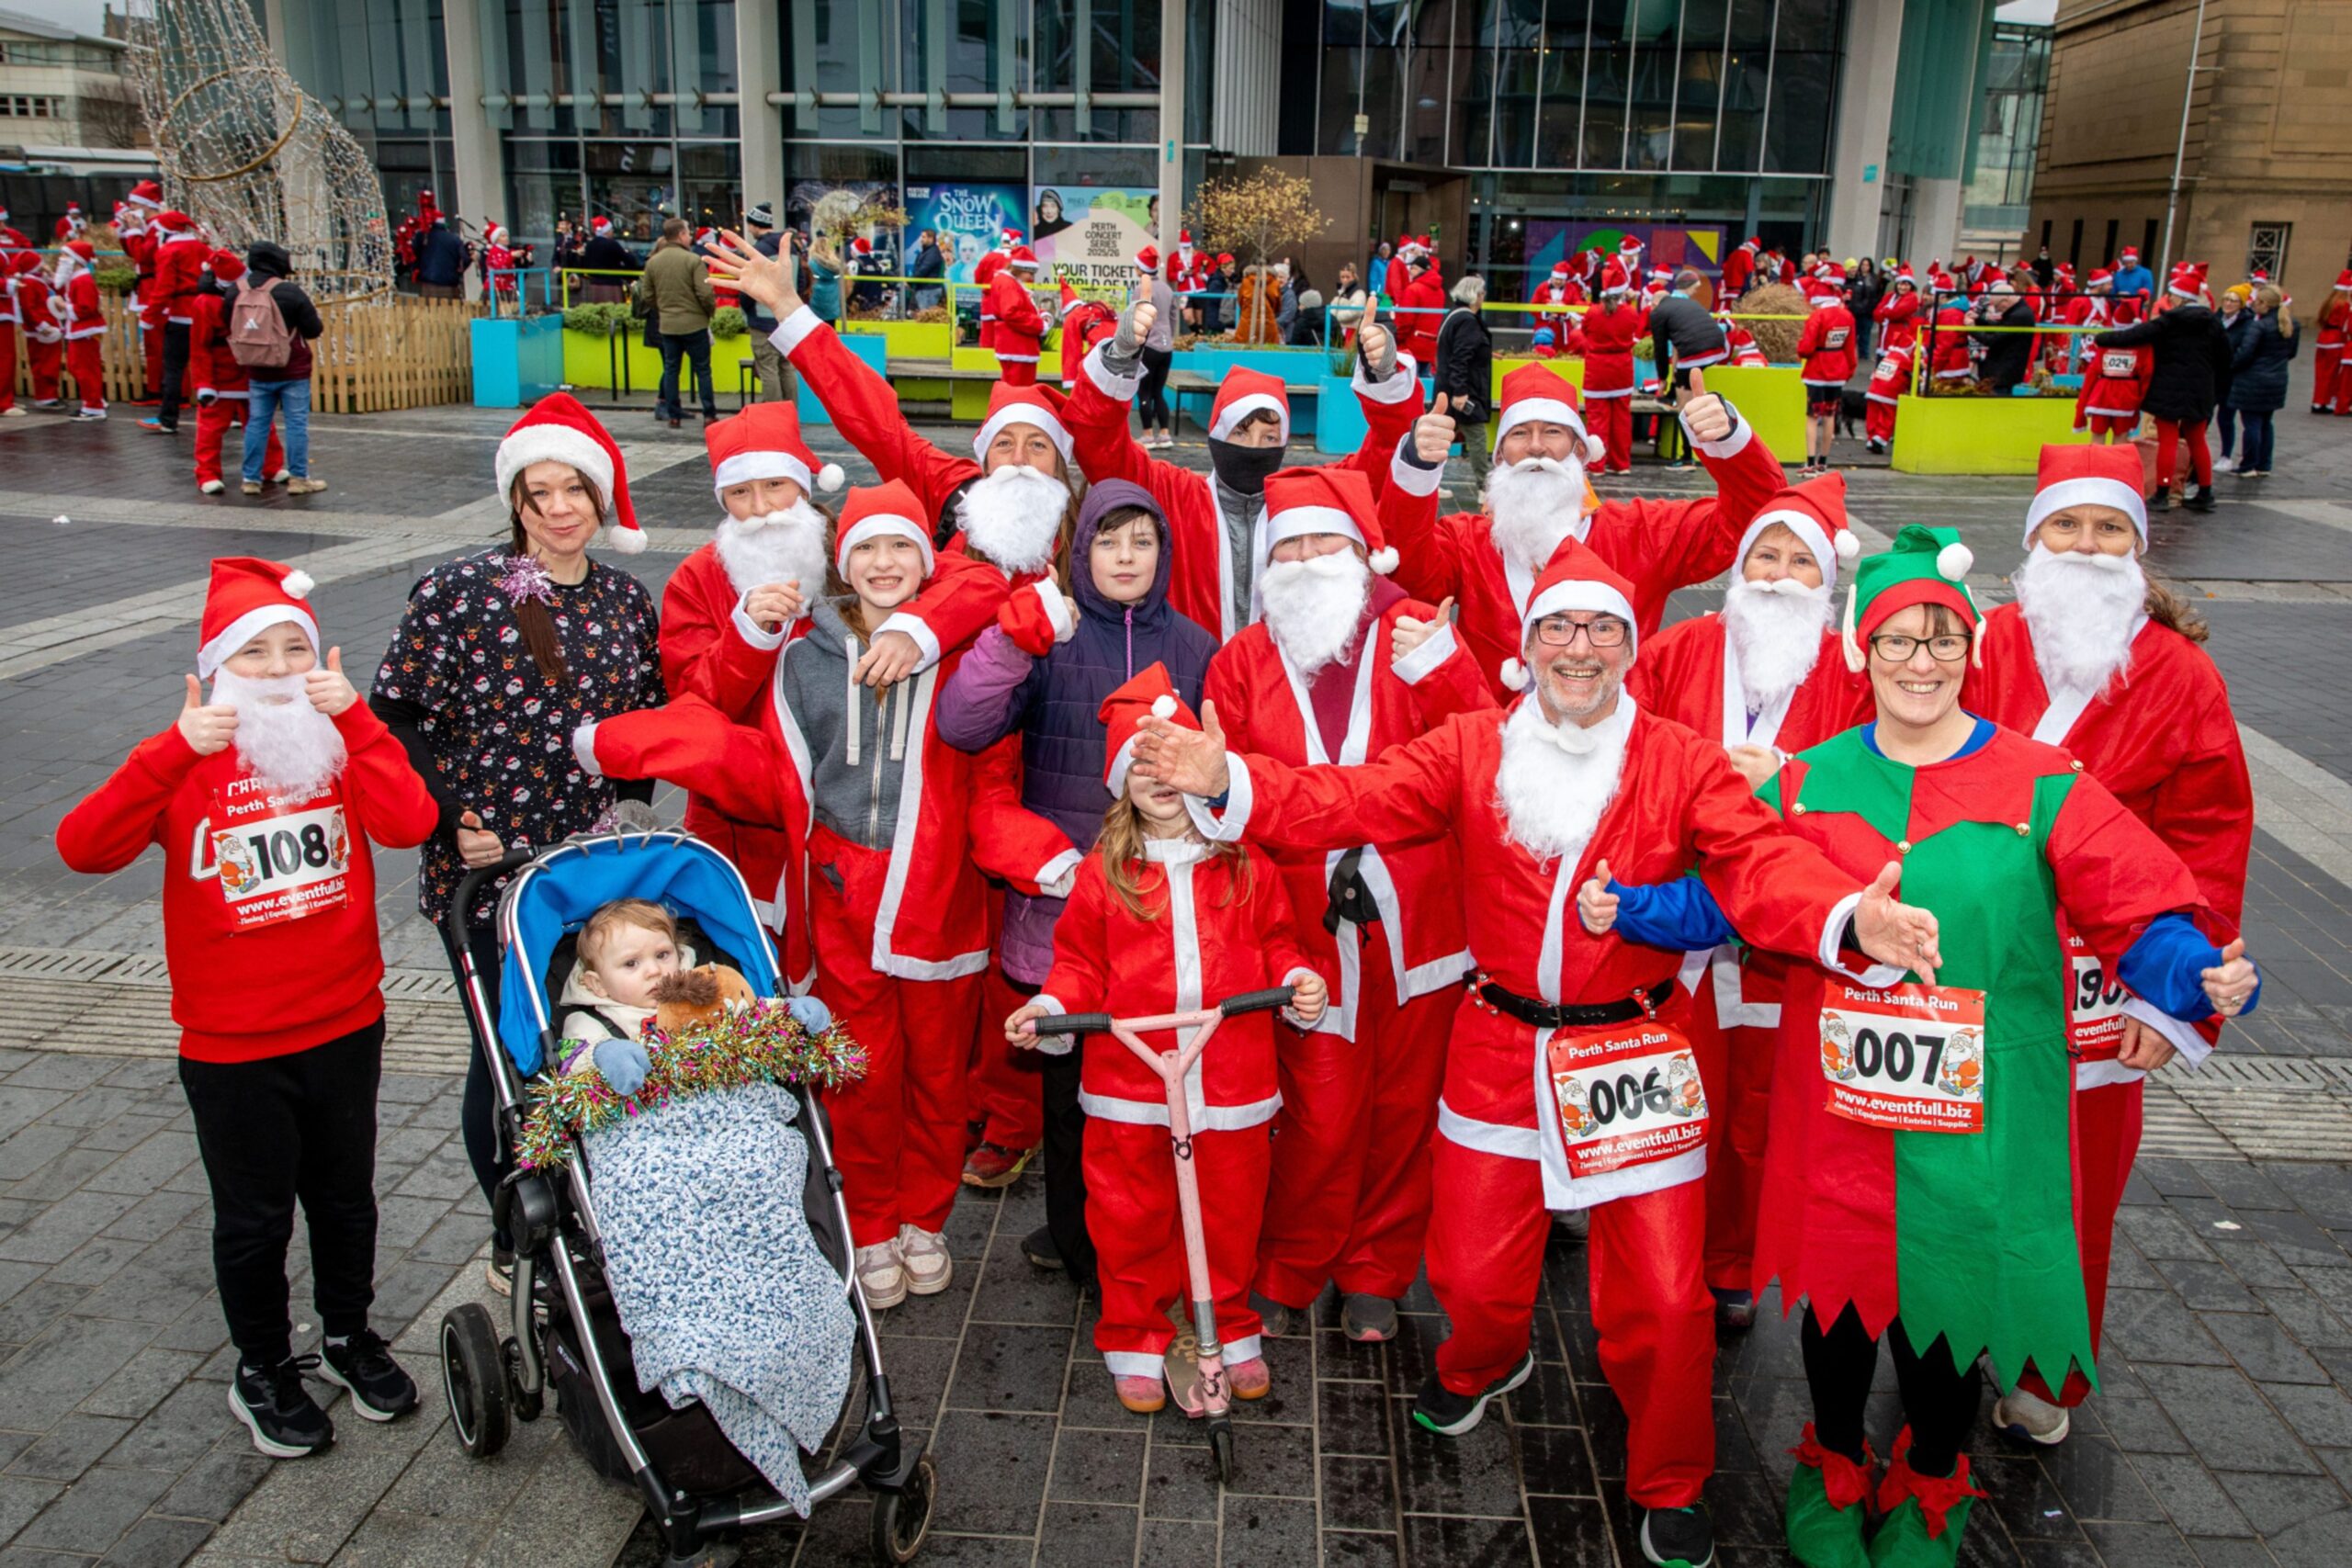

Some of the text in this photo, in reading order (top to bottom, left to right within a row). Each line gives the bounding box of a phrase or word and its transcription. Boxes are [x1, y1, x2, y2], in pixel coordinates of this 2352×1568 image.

[940, 192, 993, 214] SNOW
[954, 189, 968, 197] THE
[933, 212, 1001, 235] QUEEN
[1091, 222, 1116, 231] PERTH
[1085, 231, 1122, 240] CONCERT
[1090, 240, 1117, 248] SERIES
[1087, 248, 1120, 257] 2025/26
[1053, 264, 1134, 277] YOUR TICKET
[227, 800, 265, 818] Perth
[249, 823, 329, 880] 108
[237, 876, 345, 915] www.eventfull.biz
[1845, 987, 1959, 1011] Perth Santa Run
[1569, 1032, 1668, 1060] Perth Santa Run
[1854, 1028, 1946, 1086] 007
[1589, 1066, 1672, 1125] 006
[1834, 1087, 1973, 1119] www.eventfull.biz
[1857, 1108, 1897, 1123] Equipment
[1903, 1115, 1932, 1126] Entries
[1938, 1119, 1973, 1129] Supplie
[1577, 1123, 1702, 1159] www.eventfull.biz
[1607, 1153, 1645, 1165] Equipment
[1649, 1146, 1674, 1157] Entries
